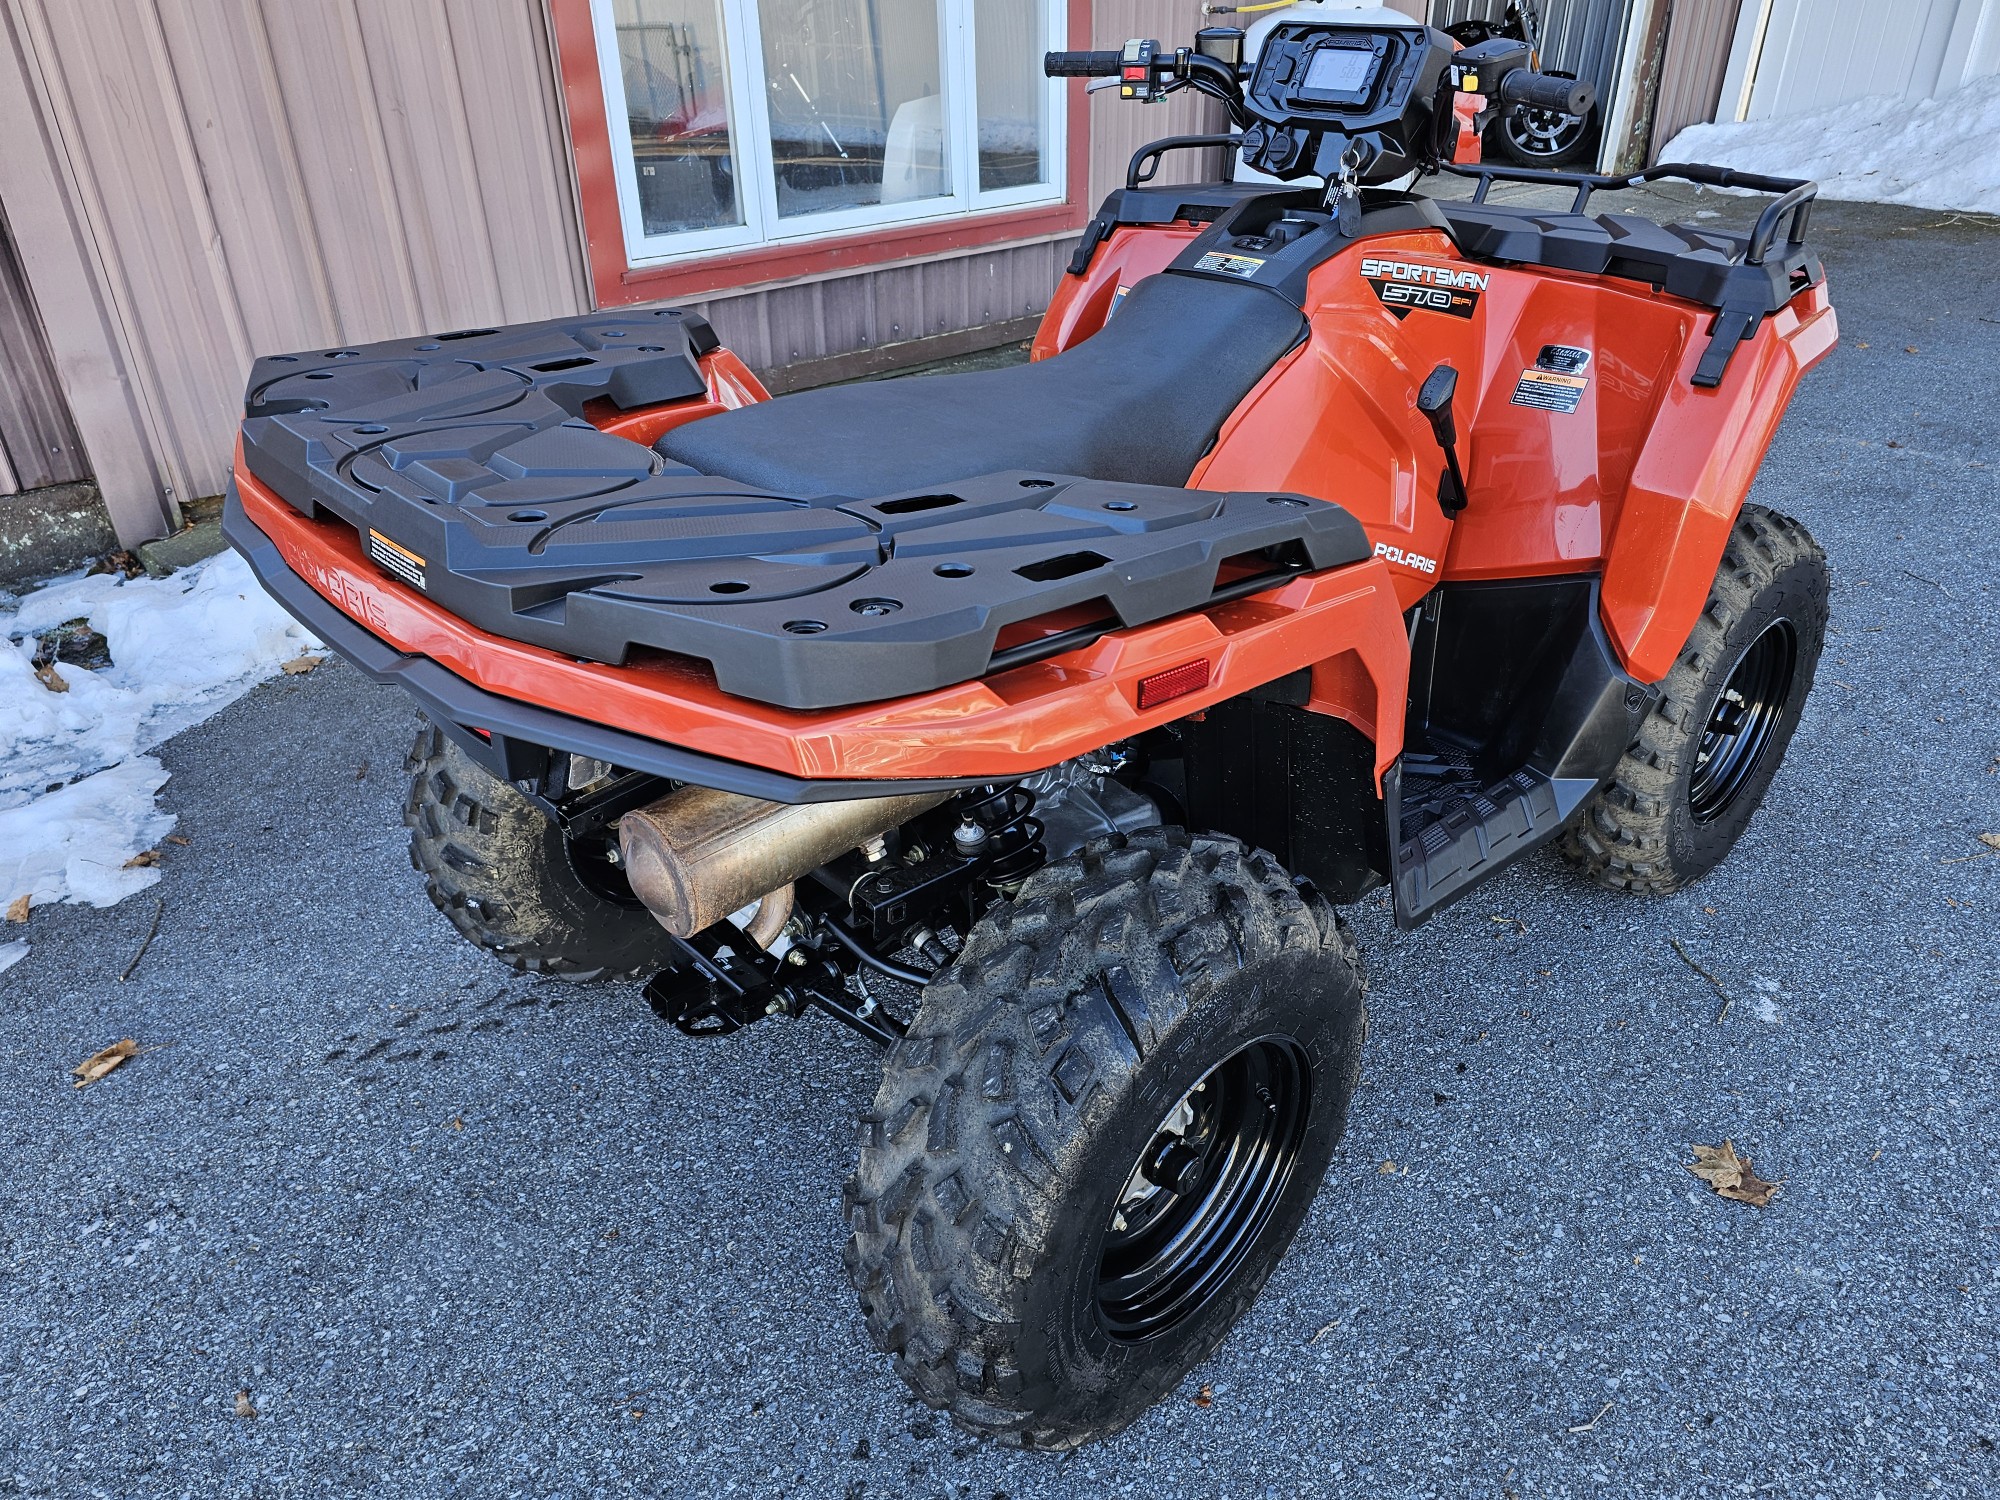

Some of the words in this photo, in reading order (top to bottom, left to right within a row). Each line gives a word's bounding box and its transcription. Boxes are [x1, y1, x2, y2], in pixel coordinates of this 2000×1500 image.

[1360, 258, 1490, 291] SPORTSMAN
[1382, 283, 1452, 309] 570
[1542, 375, 1572, 385] WARNING
[1373, 542, 1437, 574] POLARIS
